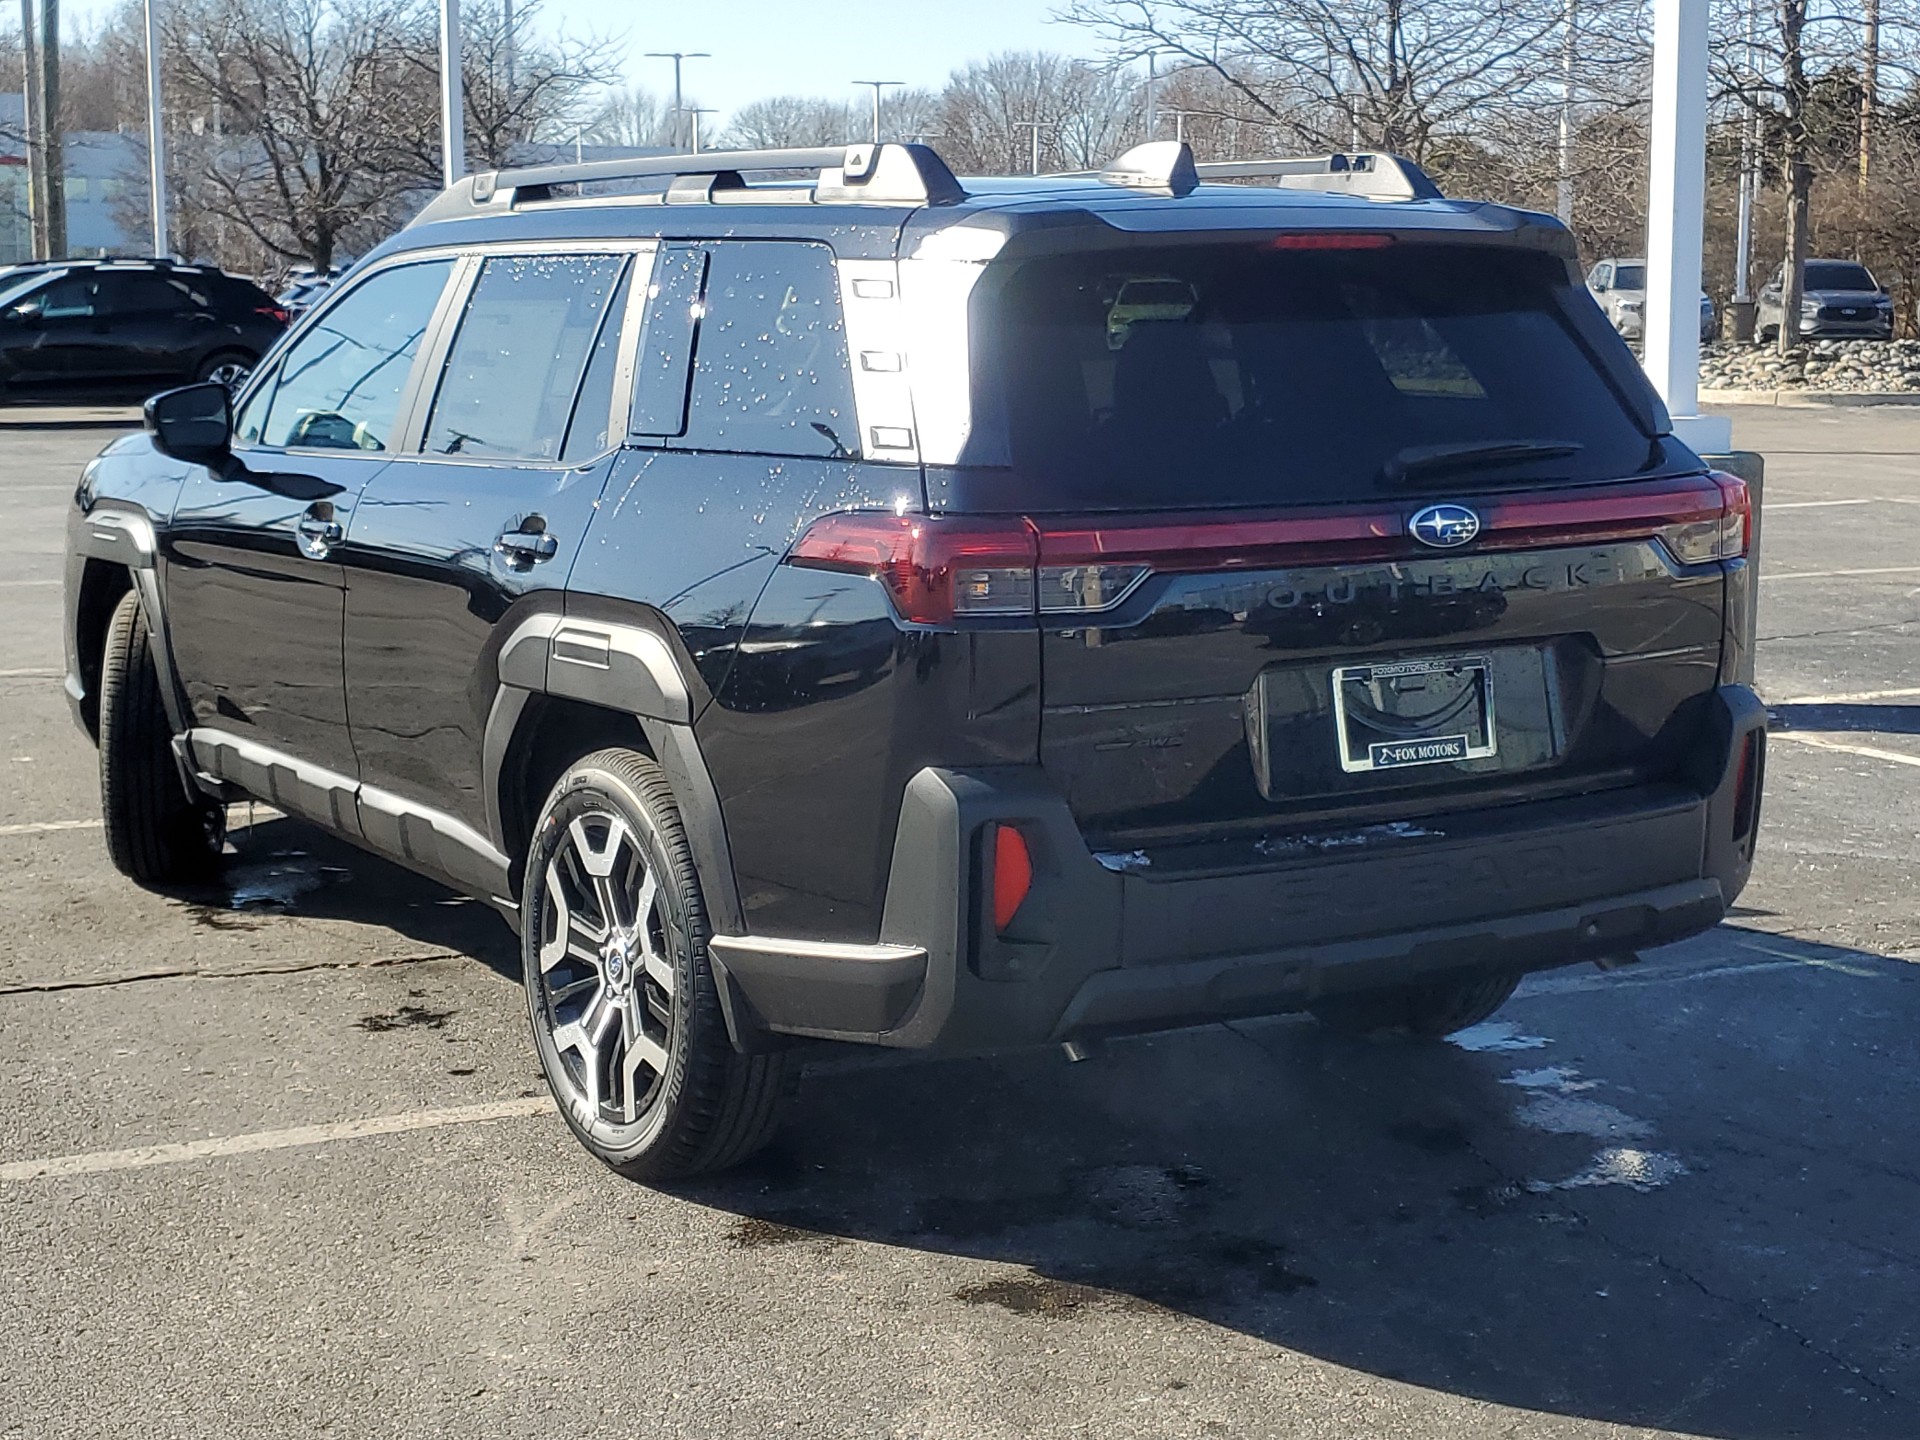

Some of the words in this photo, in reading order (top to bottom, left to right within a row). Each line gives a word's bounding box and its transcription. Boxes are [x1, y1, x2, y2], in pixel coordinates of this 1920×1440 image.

[1267, 563, 1589, 609] OUTBACK
[1395, 747, 1417, 761] FOX
[1418, 743, 1460, 759] MOTORS
